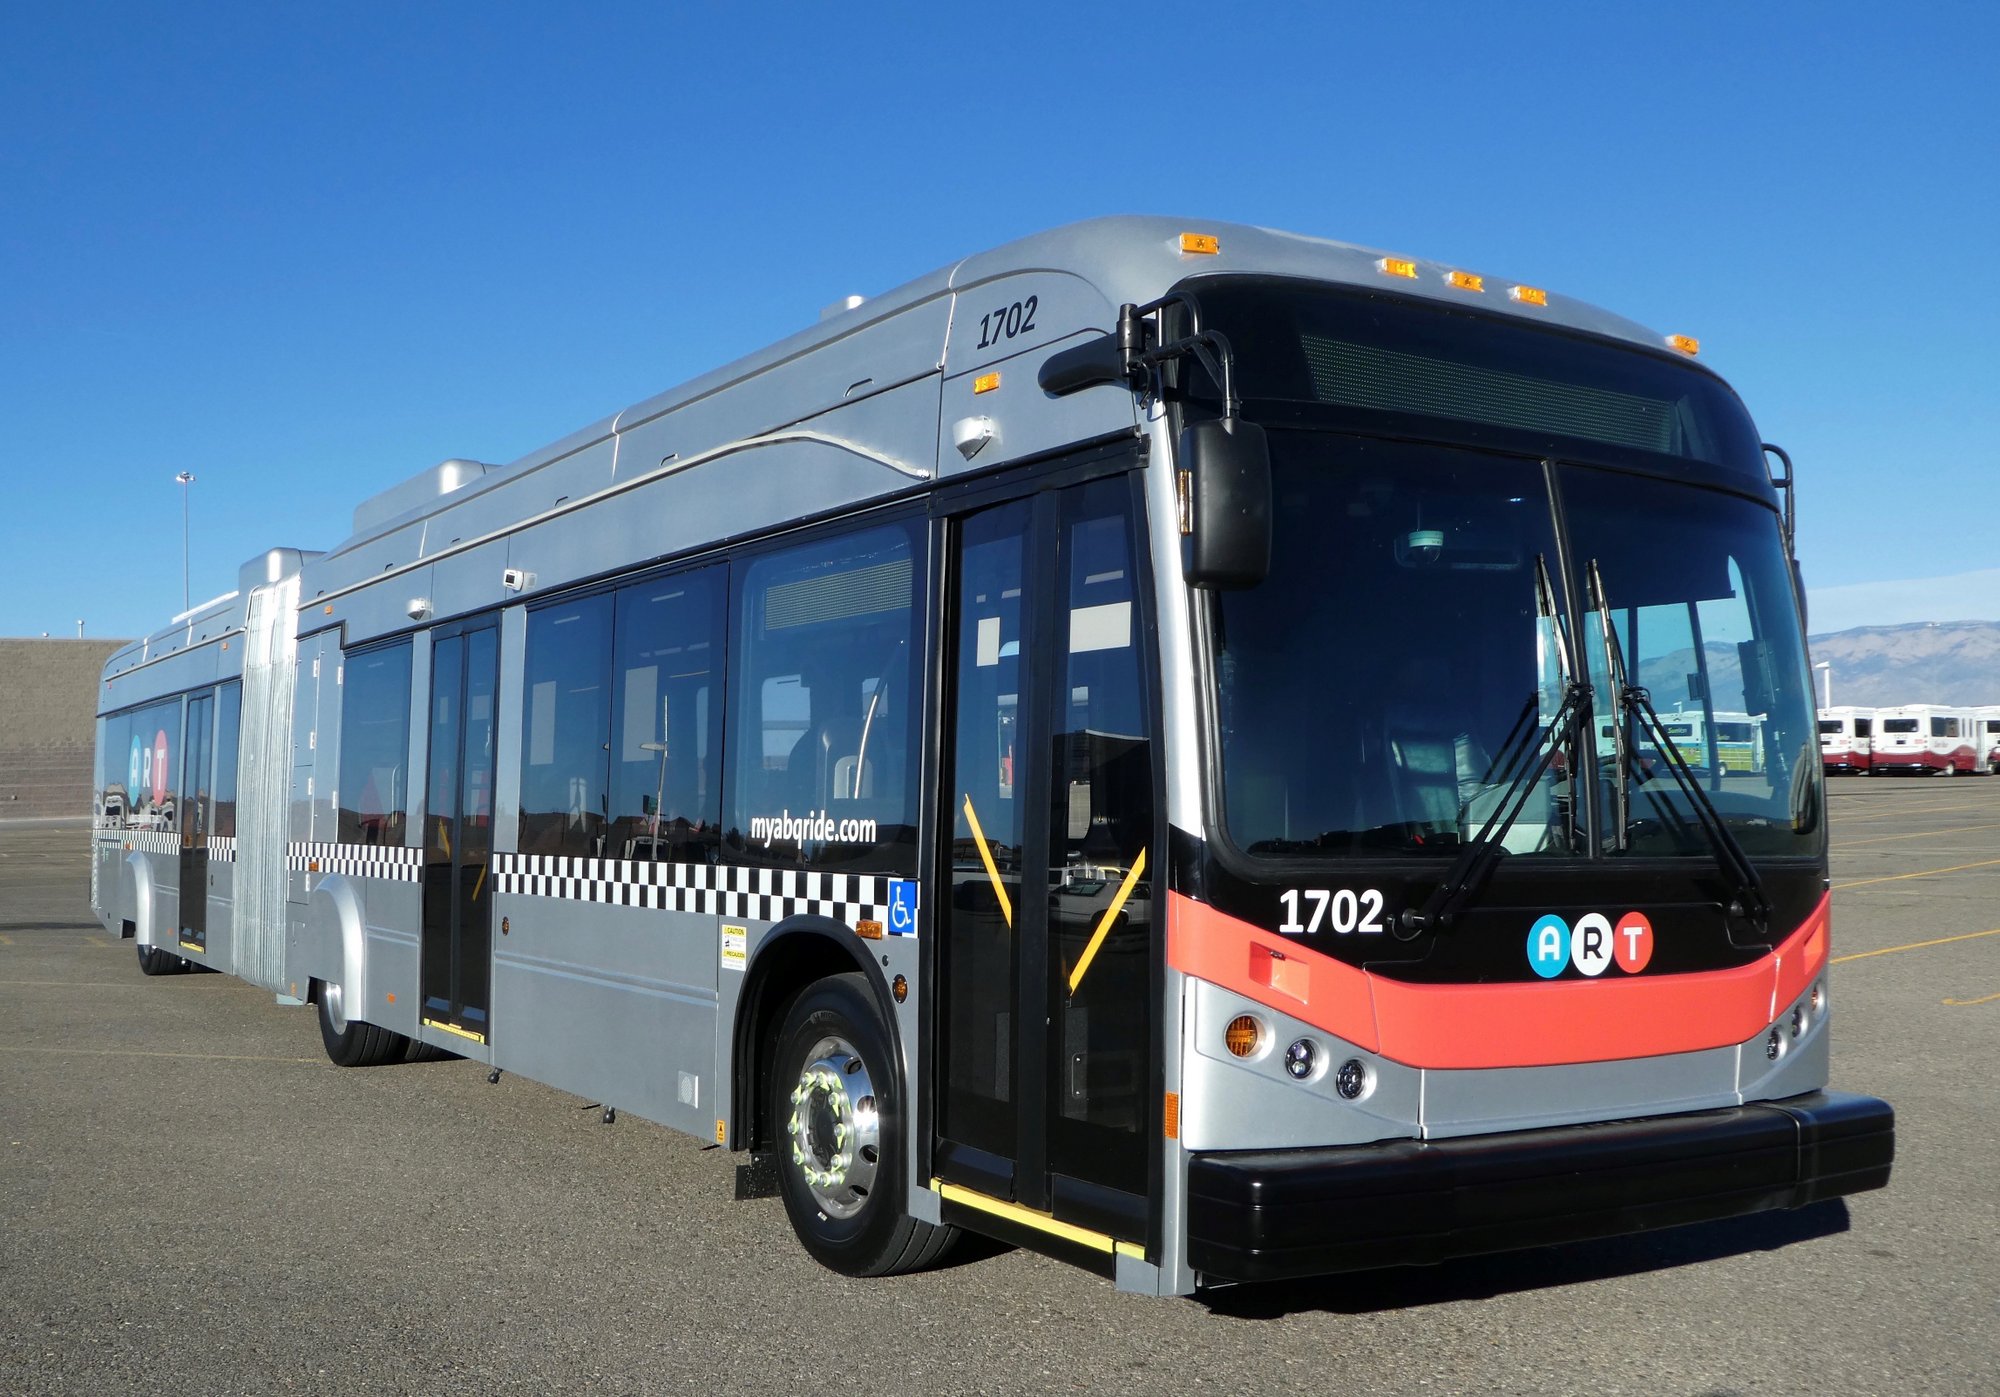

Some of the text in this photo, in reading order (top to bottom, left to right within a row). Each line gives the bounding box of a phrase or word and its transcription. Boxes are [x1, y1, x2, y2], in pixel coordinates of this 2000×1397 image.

[977, 294, 1038, 350] 1702
[131, 747, 165, 790] ART
[751, 809, 876, 849] myabqride.com
[1279, 889, 1384, 933] 1702
[1537, 925, 1643, 961] ART
